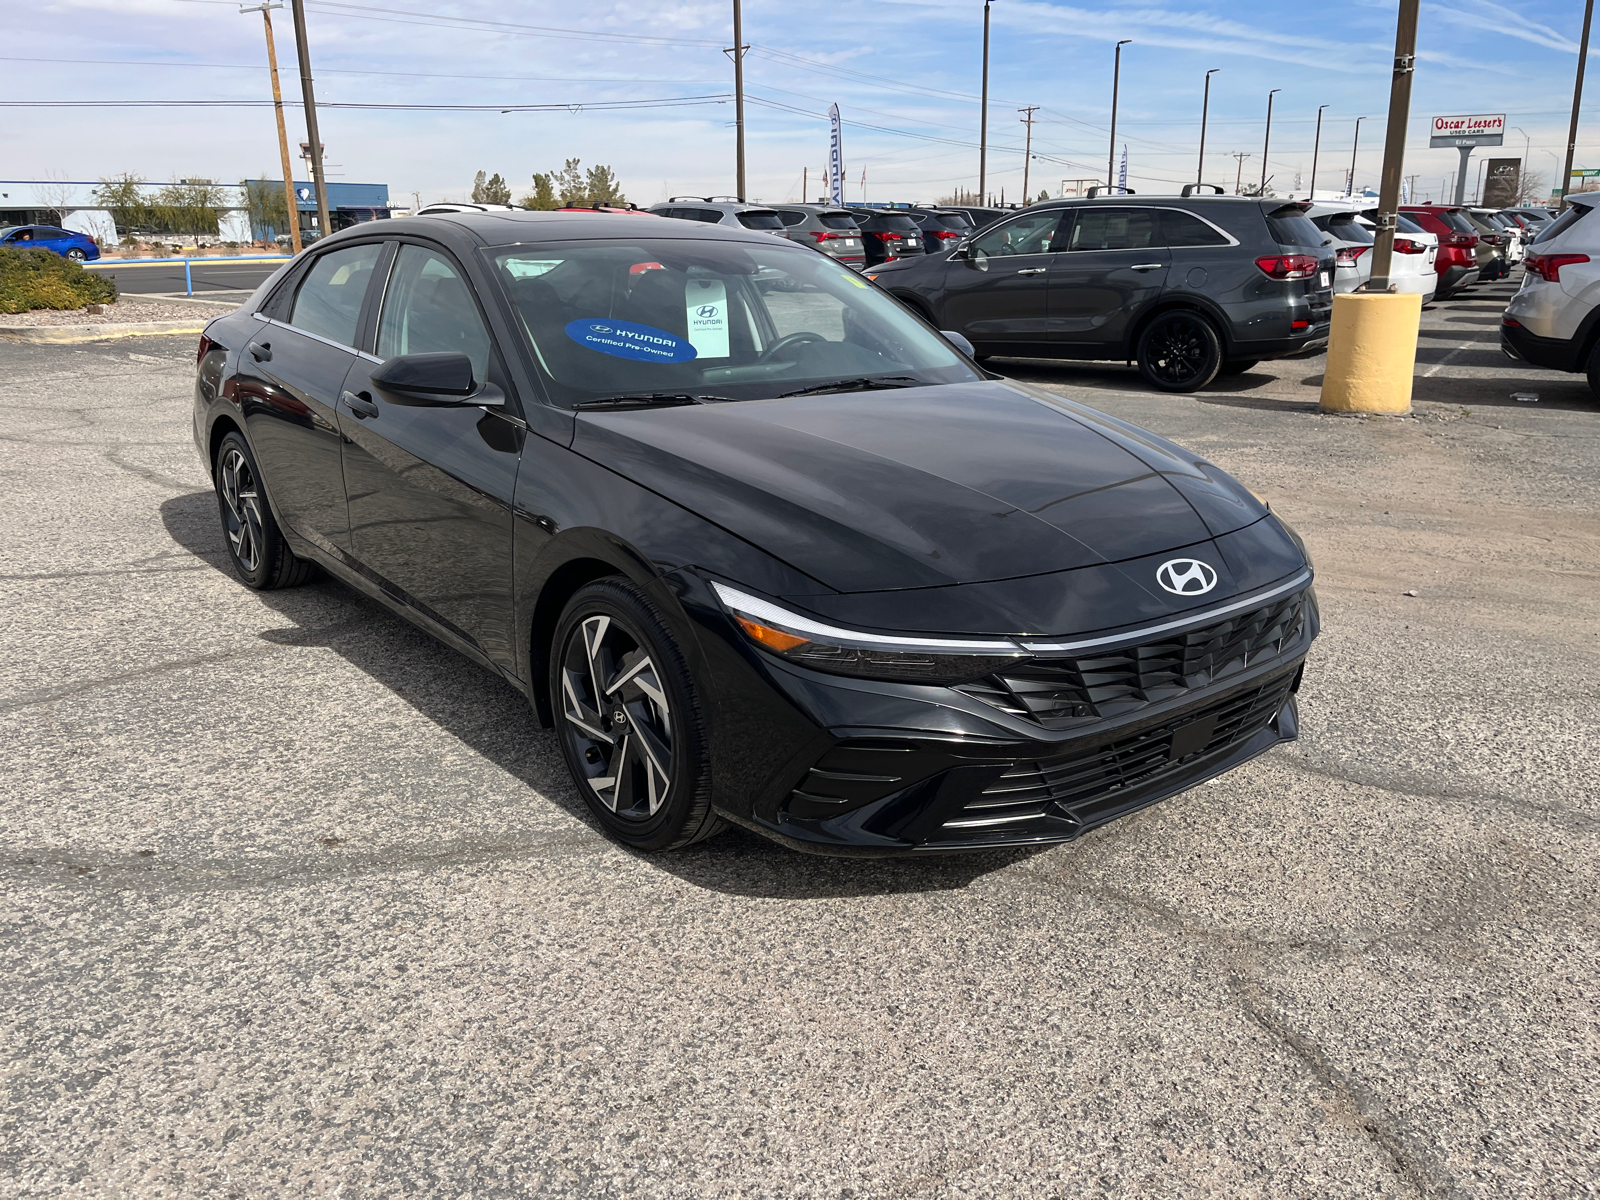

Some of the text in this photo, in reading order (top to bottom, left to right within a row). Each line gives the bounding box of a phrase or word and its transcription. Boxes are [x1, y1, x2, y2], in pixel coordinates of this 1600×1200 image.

[1435, 117, 1503, 130] Oscar Leeser's
[586, 335, 674, 357] Certified Pre-Owned
[616, 329, 676, 347] HYUNDAI
